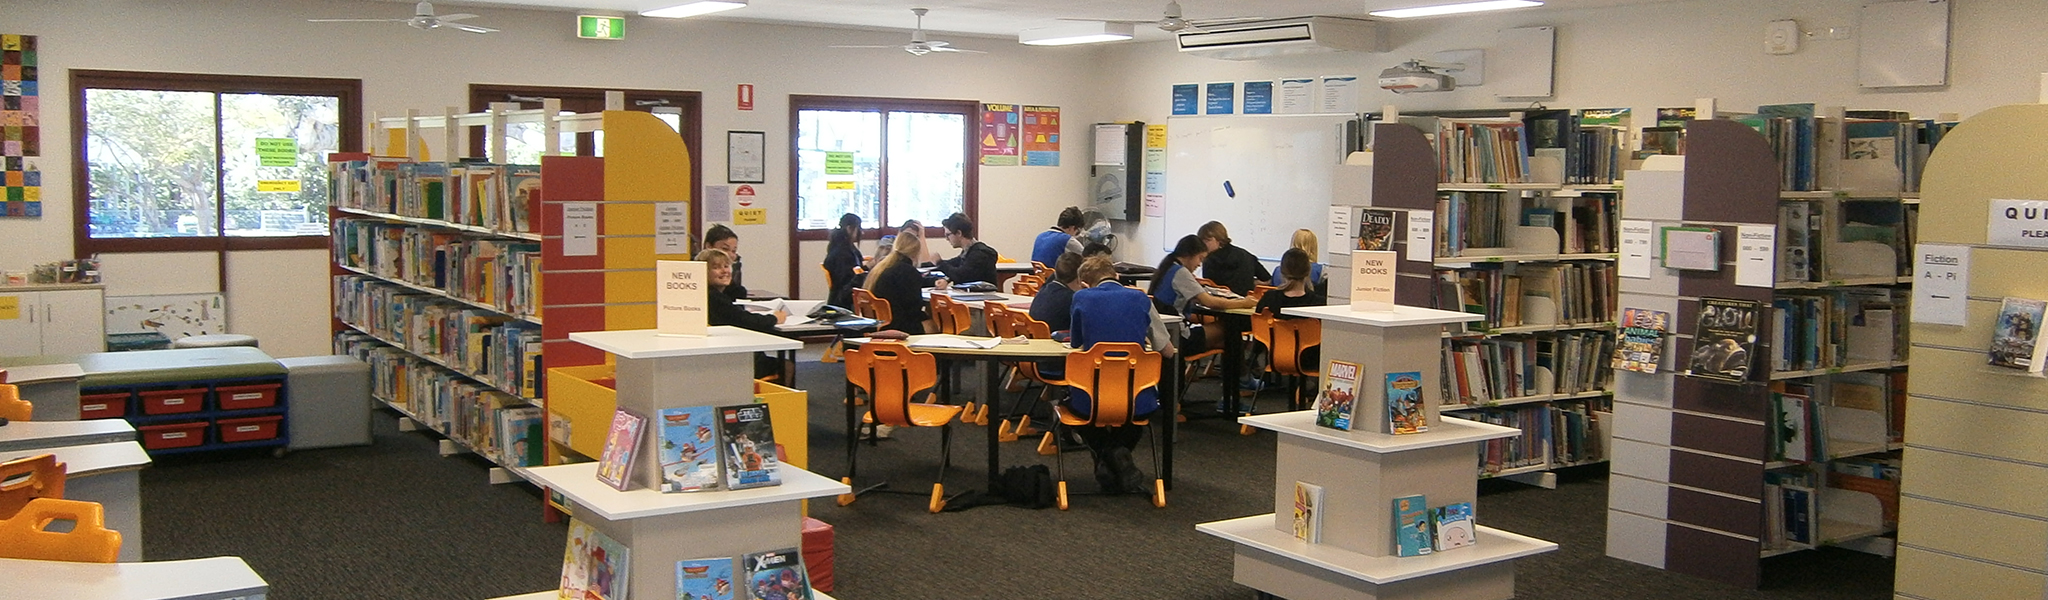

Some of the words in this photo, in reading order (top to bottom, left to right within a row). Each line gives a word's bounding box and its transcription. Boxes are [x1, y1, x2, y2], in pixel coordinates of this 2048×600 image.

[986, 104, 1013, 112] VOLUME
[1362, 212, 1390, 225] DEADLY
[1924, 254, 1958, 264] Fiction
[672, 272, 692, 280] NEW
[1925, 271, 1932, 279] A
[1946, 272, 1957, 281] Pi
[666, 281, 698, 290] BOOKS
[1623, 327, 1660, 338] ANIMAL
[1330, 362, 1357, 380] MARVEL
